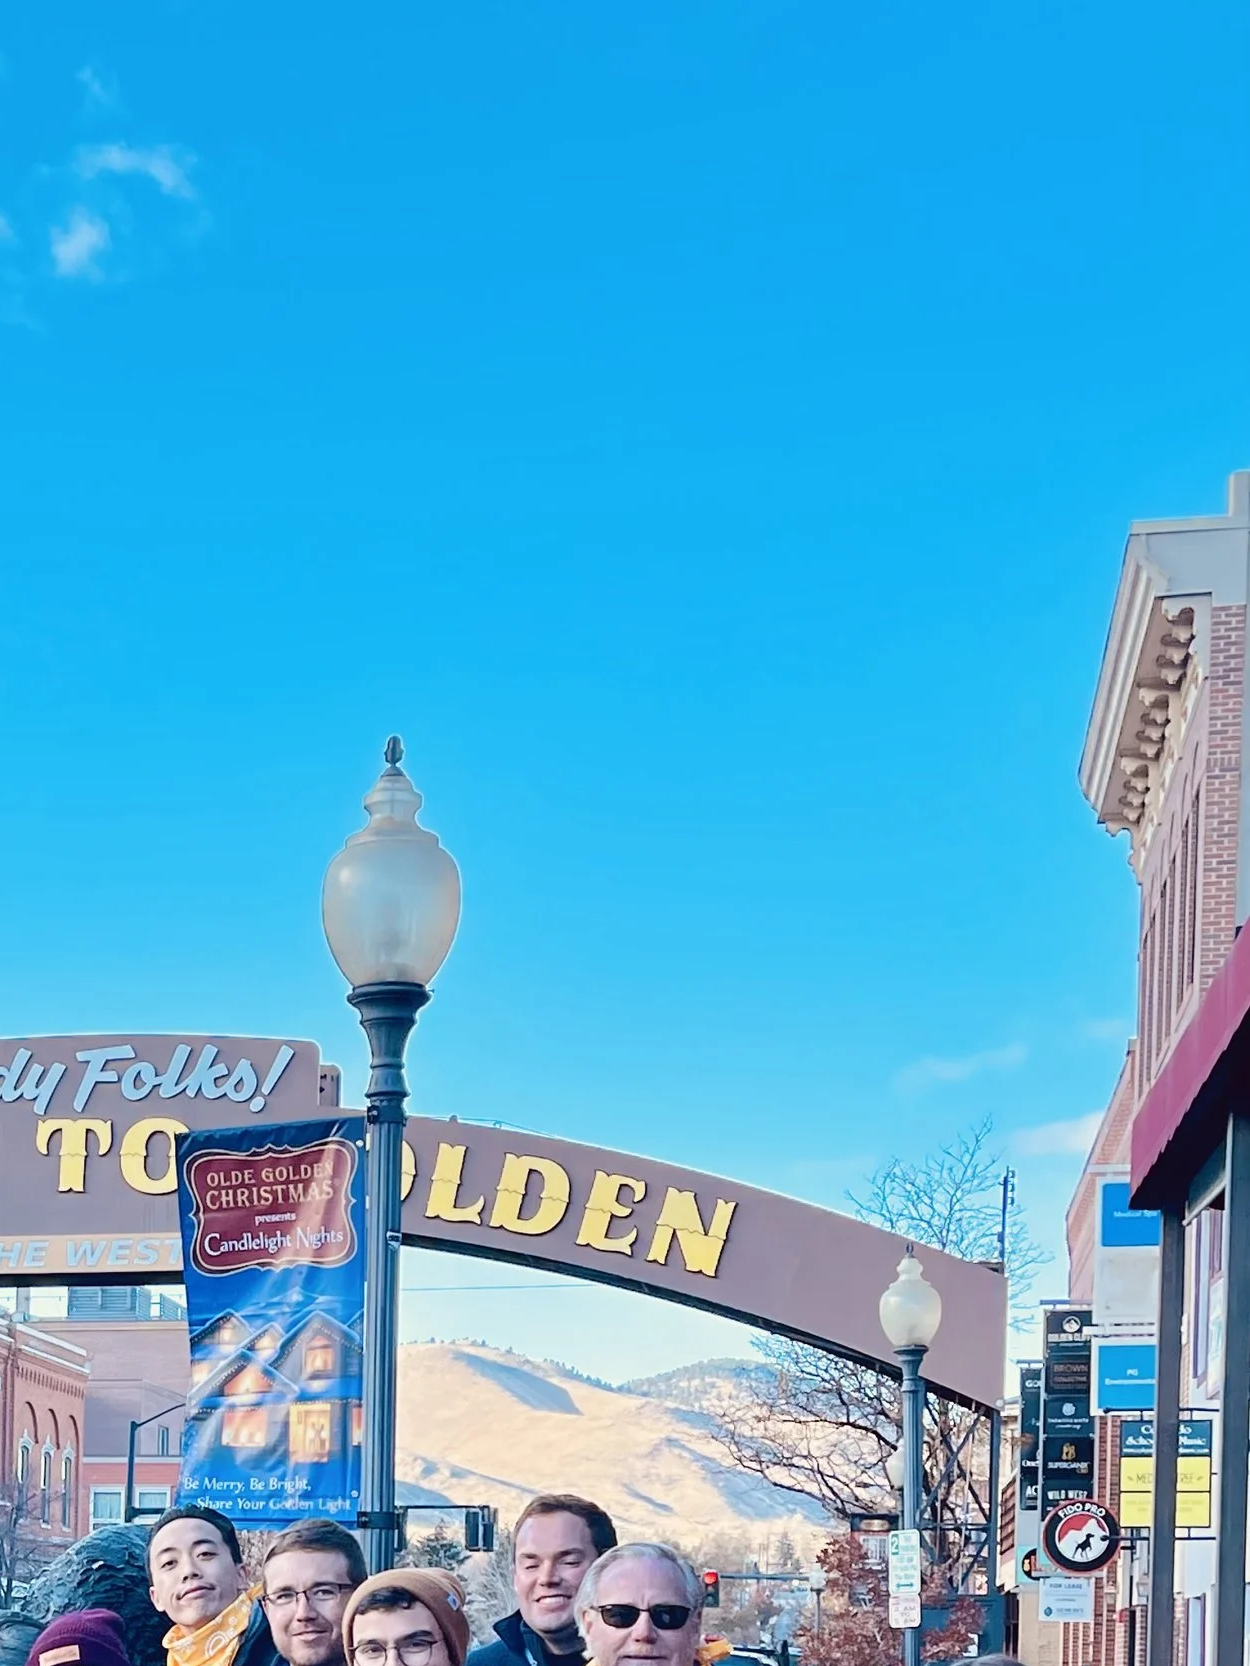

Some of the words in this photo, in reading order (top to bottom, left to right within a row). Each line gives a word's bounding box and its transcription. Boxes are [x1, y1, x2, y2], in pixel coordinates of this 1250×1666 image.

[73, 1043, 295, 1113] Folks!
[206, 1168, 256, 1188] OLDE
[261, 1160, 334, 1183] GOLDEN
[36, 1116, 191, 1196] TO
[401, 1140, 738, 1279] LDEN
[205, 1180, 334, 1210] CHRISTMAS
[254, 1211, 297, 1226] presents
[67, 1238, 182, 1267] WEST
[204, 1230, 292, 1256] Candlelight
[296, 1226, 344, 1250] Nights
[1053, 1364, 1089, 1372] BROWN
[184, 1477, 199, 1490] Be
[202, 1477, 245, 1494] Merry,
[250, 1477, 266, 1490] Be
[269, 1476, 312, 1493] Bright,
[197, 1497, 233, 1511] Share
[237, 1497, 266, 1511] Your
[269, 1497, 314, 1511] Golden
[1057, 1502, 1083, 1519] FIDO
[1084, 1502, 1106, 1518] PRO
